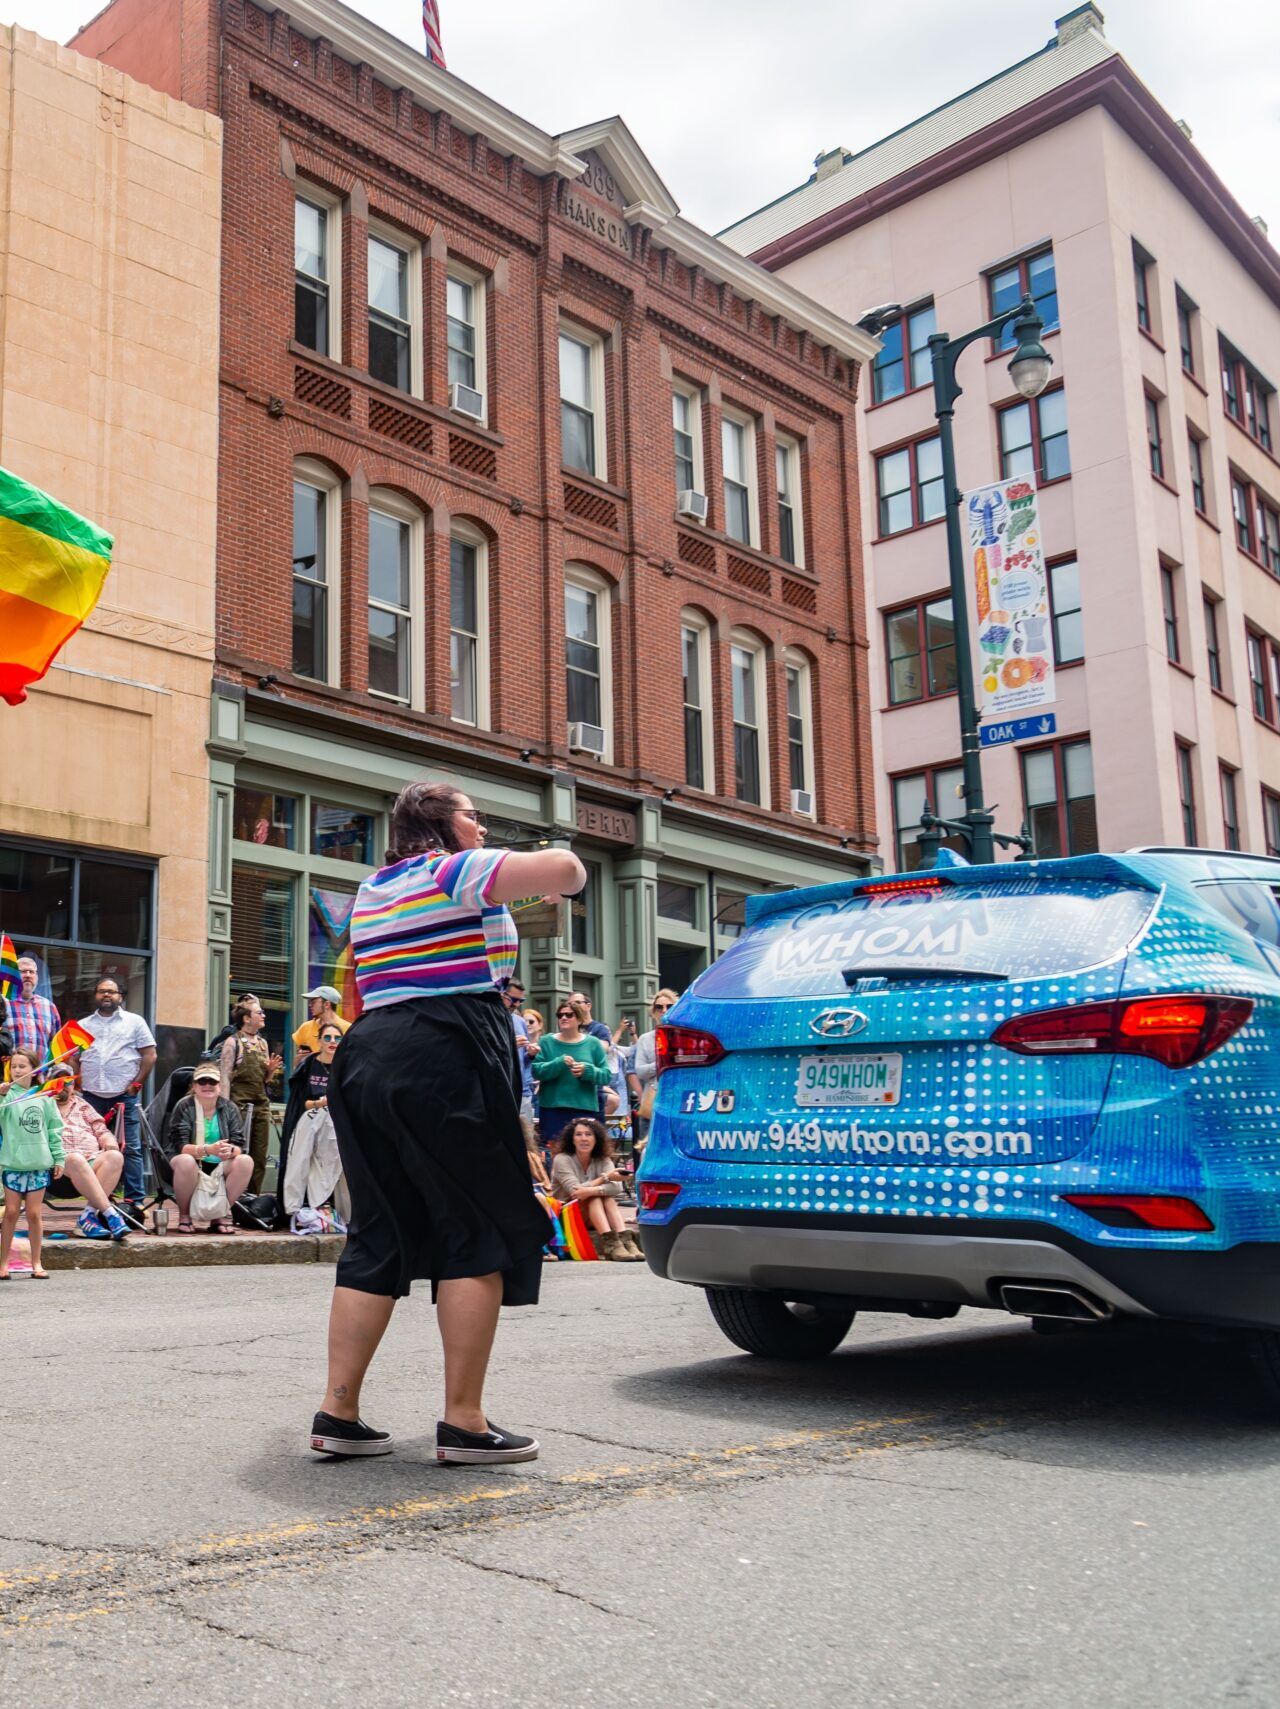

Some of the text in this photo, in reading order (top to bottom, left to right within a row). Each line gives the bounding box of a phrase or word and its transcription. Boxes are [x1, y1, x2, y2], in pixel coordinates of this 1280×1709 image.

[563, 199, 630, 251] HANSON
[988, 721, 1028, 742] OAK ST
[778, 919, 960, 967] WHOM
[805, 1063, 887, 1089] 949WHOM
[696, 1122, 1033, 1155] www.949whom.com
